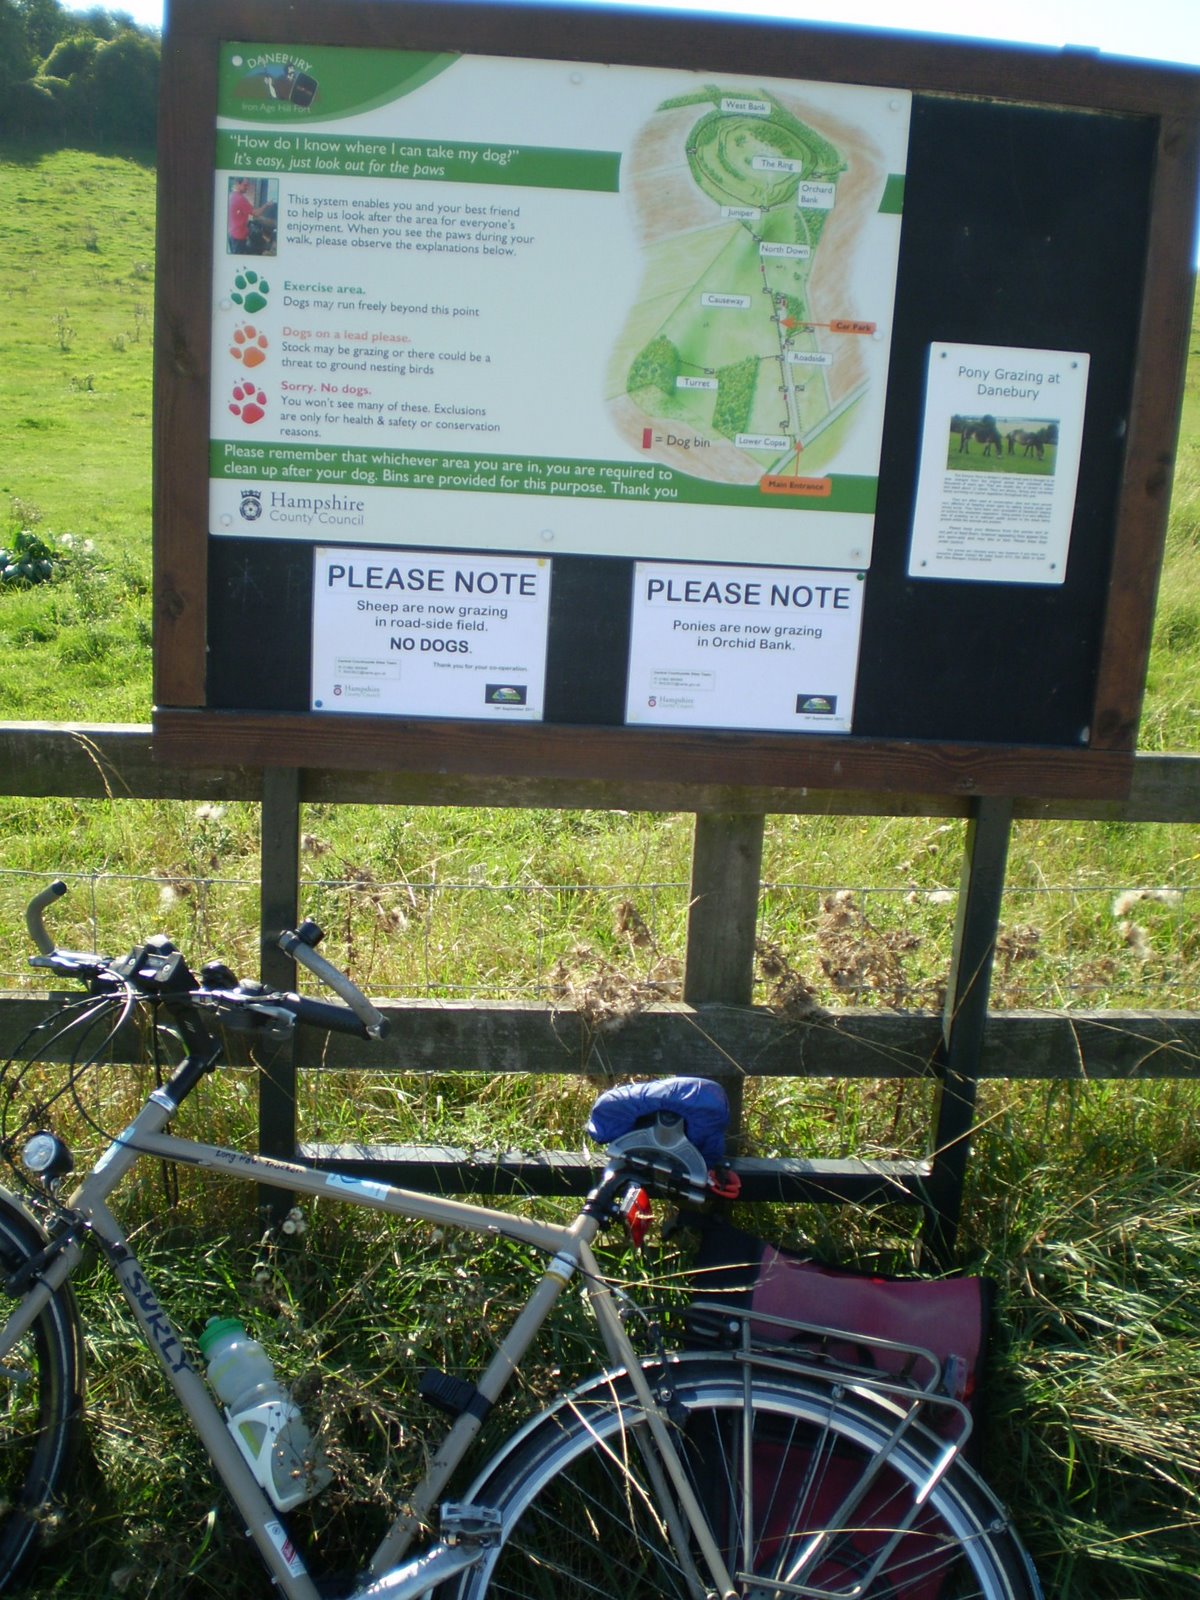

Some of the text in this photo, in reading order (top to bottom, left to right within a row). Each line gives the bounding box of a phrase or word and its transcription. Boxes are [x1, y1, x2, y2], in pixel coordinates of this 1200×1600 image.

[247, 53, 312, 71] DANEBURY
[727, 101, 745, 109] West
[274, 136, 290, 149] do
[304, 138, 340, 151] know
[344, 141, 386, 154] where
[399, 146, 421, 156] can
[426, 145, 453, 158] take
[458, 150, 478, 162] my
[234, 153, 444, 176] It's easy, just look out for the paws
[762, 159, 793, 170] The Ring
[801, 184, 832, 193] Orchard
[289, 194, 519, 216] This system enables you and your best friend
[728, 208, 753, 217] Juniper
[284, 281, 332, 292] Exercise
[283, 296, 309, 309] Dogs
[313, 300, 333, 310] may
[358, 300, 386, 313] freely
[390, 303, 427, 314] beyond
[431, 305, 449, 314] this
[452, 308, 479, 316] point
[708, 295, 743, 305] Causeway
[836, 322, 849, 330] Car
[282, 326, 311, 339] Dogs
[344, 330, 368, 340] lead
[372, 332, 411, 344] please.
[282, 342, 310, 352] Stock
[313, 346, 334, 356] may
[337, 345, 349, 354] be
[353, 348, 389, 359] grazing
[407, 349, 434, 359] there
[438, 352, 466, 360] could
[469, 352, 481, 362] be
[793, 353, 825, 362] Roadside
[281, 358, 312, 368] threat
[329, 362, 366, 371] ground
[370, 364, 405, 375] nesting
[409, 364, 434, 374] birds
[684, 379, 710, 387] Turret
[958, 366, 1059, 384] Pony Grazing at
[281, 380, 371, 396] Sorry. No dogs.
[977, 384, 1039, 400] Danebury
[282, 396, 301, 406] You
[304, 398, 333, 407] won't
[357, 402, 383, 412] many
[387, 402, 397, 410] of
[401, 402, 430, 412] these.
[434, 403, 486, 415] Exclusions
[666, 434, 711, 449] Dog bin
[764, 438, 786, 447] Copse
[224, 444, 672, 480] Please remember that whichever area you are in, you are required to
[224, 461, 677, 499] clean up after your dog. Bins are provided for this purpose. Thank you
[789, 480, 824, 490] Entrance
[271, 492, 364, 514] Hampshire
[270, 511, 364, 525] County Council
[328, 565, 536, 595] PLEASE NOTE
[647, 579, 850, 608] PLEASE NOTE
[357, 600, 507, 619] Sheep are now grazing
[375, 617, 487, 631] in road-side field.
[673, 620, 822, 638] Ponies are now grazing
[390, 637, 472, 653] NO DOGS.
[697, 637, 794, 649] in Orchid Bank.
[123, 1270, 195, 1373] SURLY
